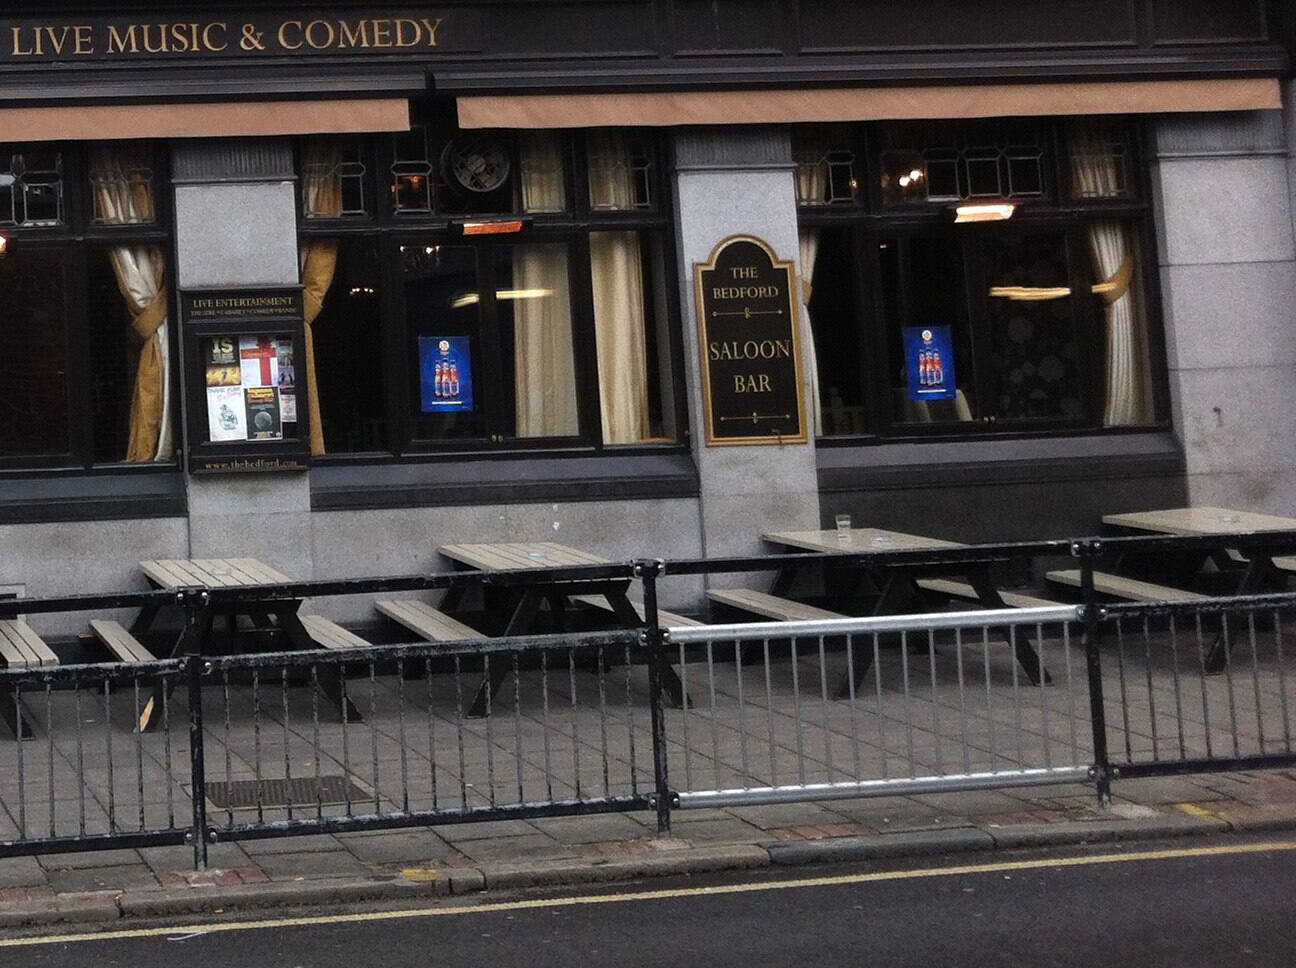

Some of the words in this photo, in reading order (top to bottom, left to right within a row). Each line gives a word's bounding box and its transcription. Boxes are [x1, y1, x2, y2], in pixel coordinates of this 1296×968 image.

[10, 25, 94, 55] LIVE
[107, 23, 228, 54] MUSIC
[239, 23, 266, 51] &
[278, 18, 443, 50] COMEDY
[729, 267, 759, 280] THE
[712, 286, 779, 300] BEDFORD
[193, 298, 213, 308] LIVE
[215, 296, 294, 308] ENTERTAINMENT
[710, 338, 791, 361] SALOON
[733, 374, 773, 394] BAR
